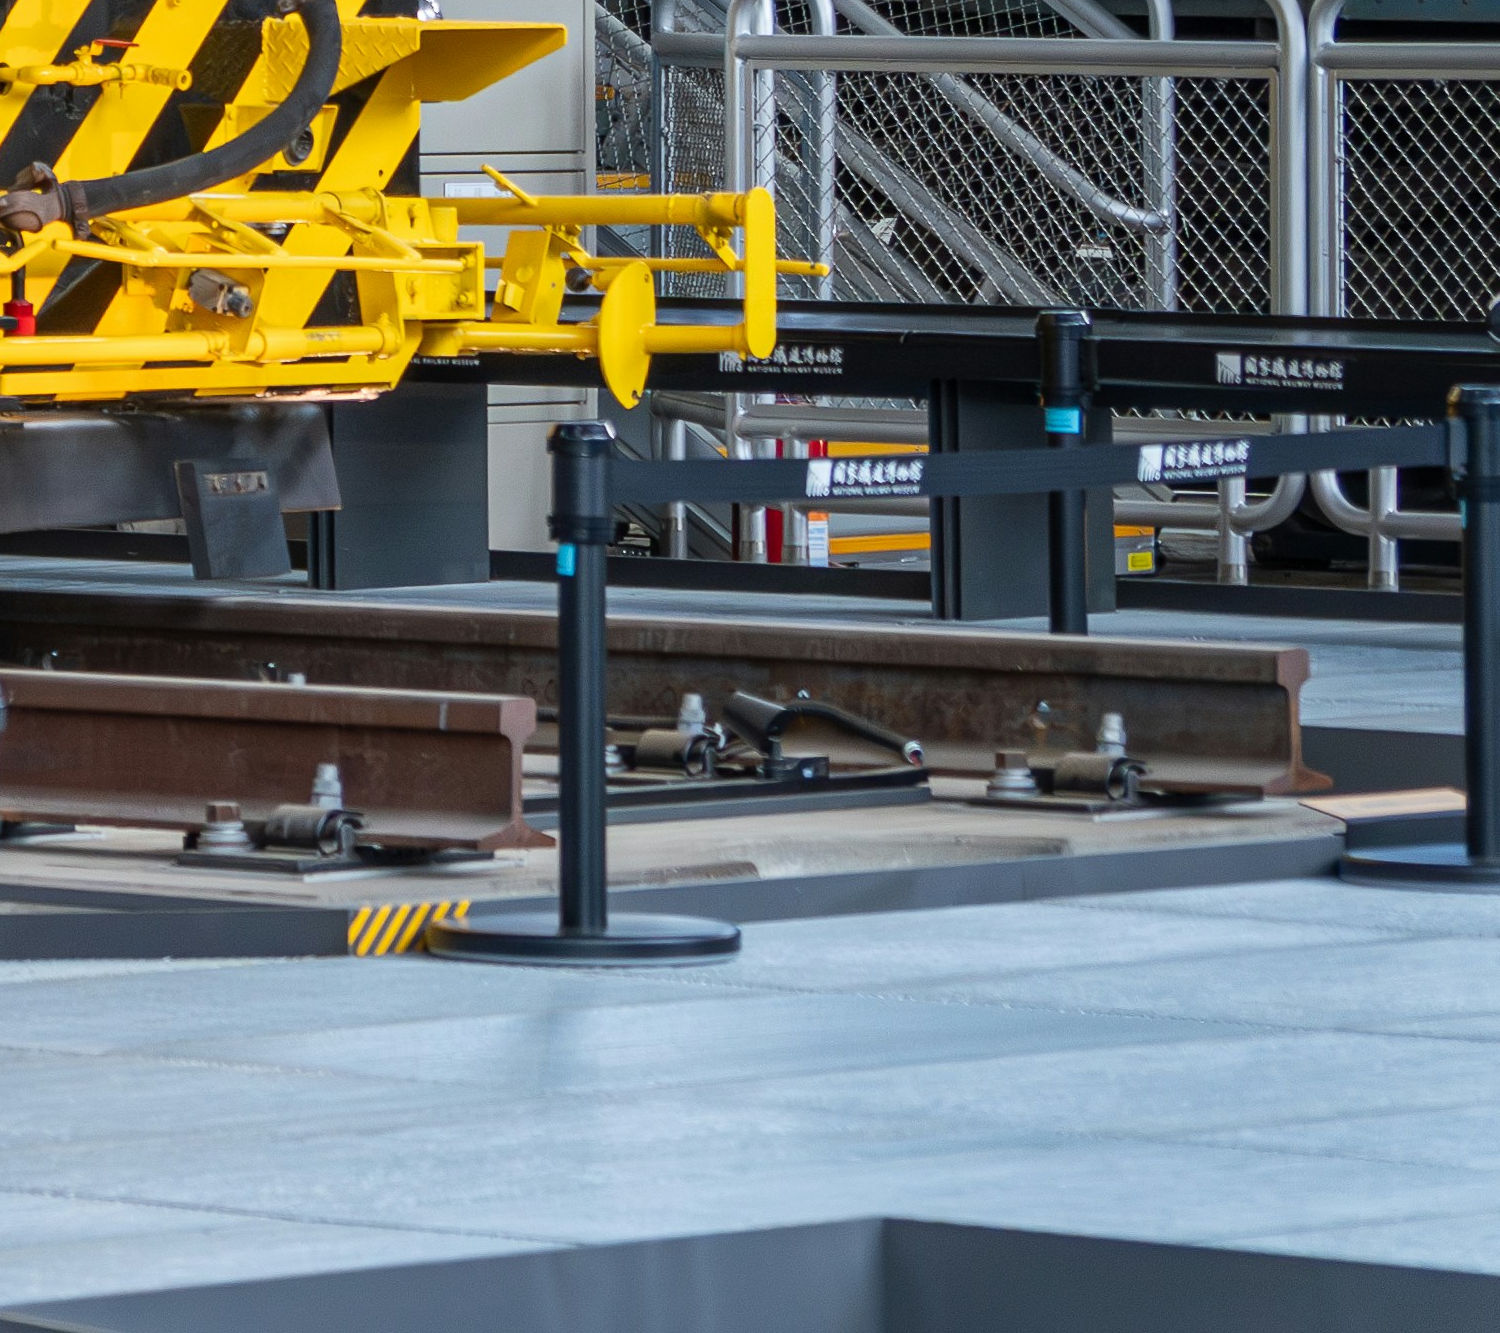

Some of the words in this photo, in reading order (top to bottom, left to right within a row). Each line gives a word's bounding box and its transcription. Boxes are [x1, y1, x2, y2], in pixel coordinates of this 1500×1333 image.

[747, 345, 843, 365] 鐵道博物館
